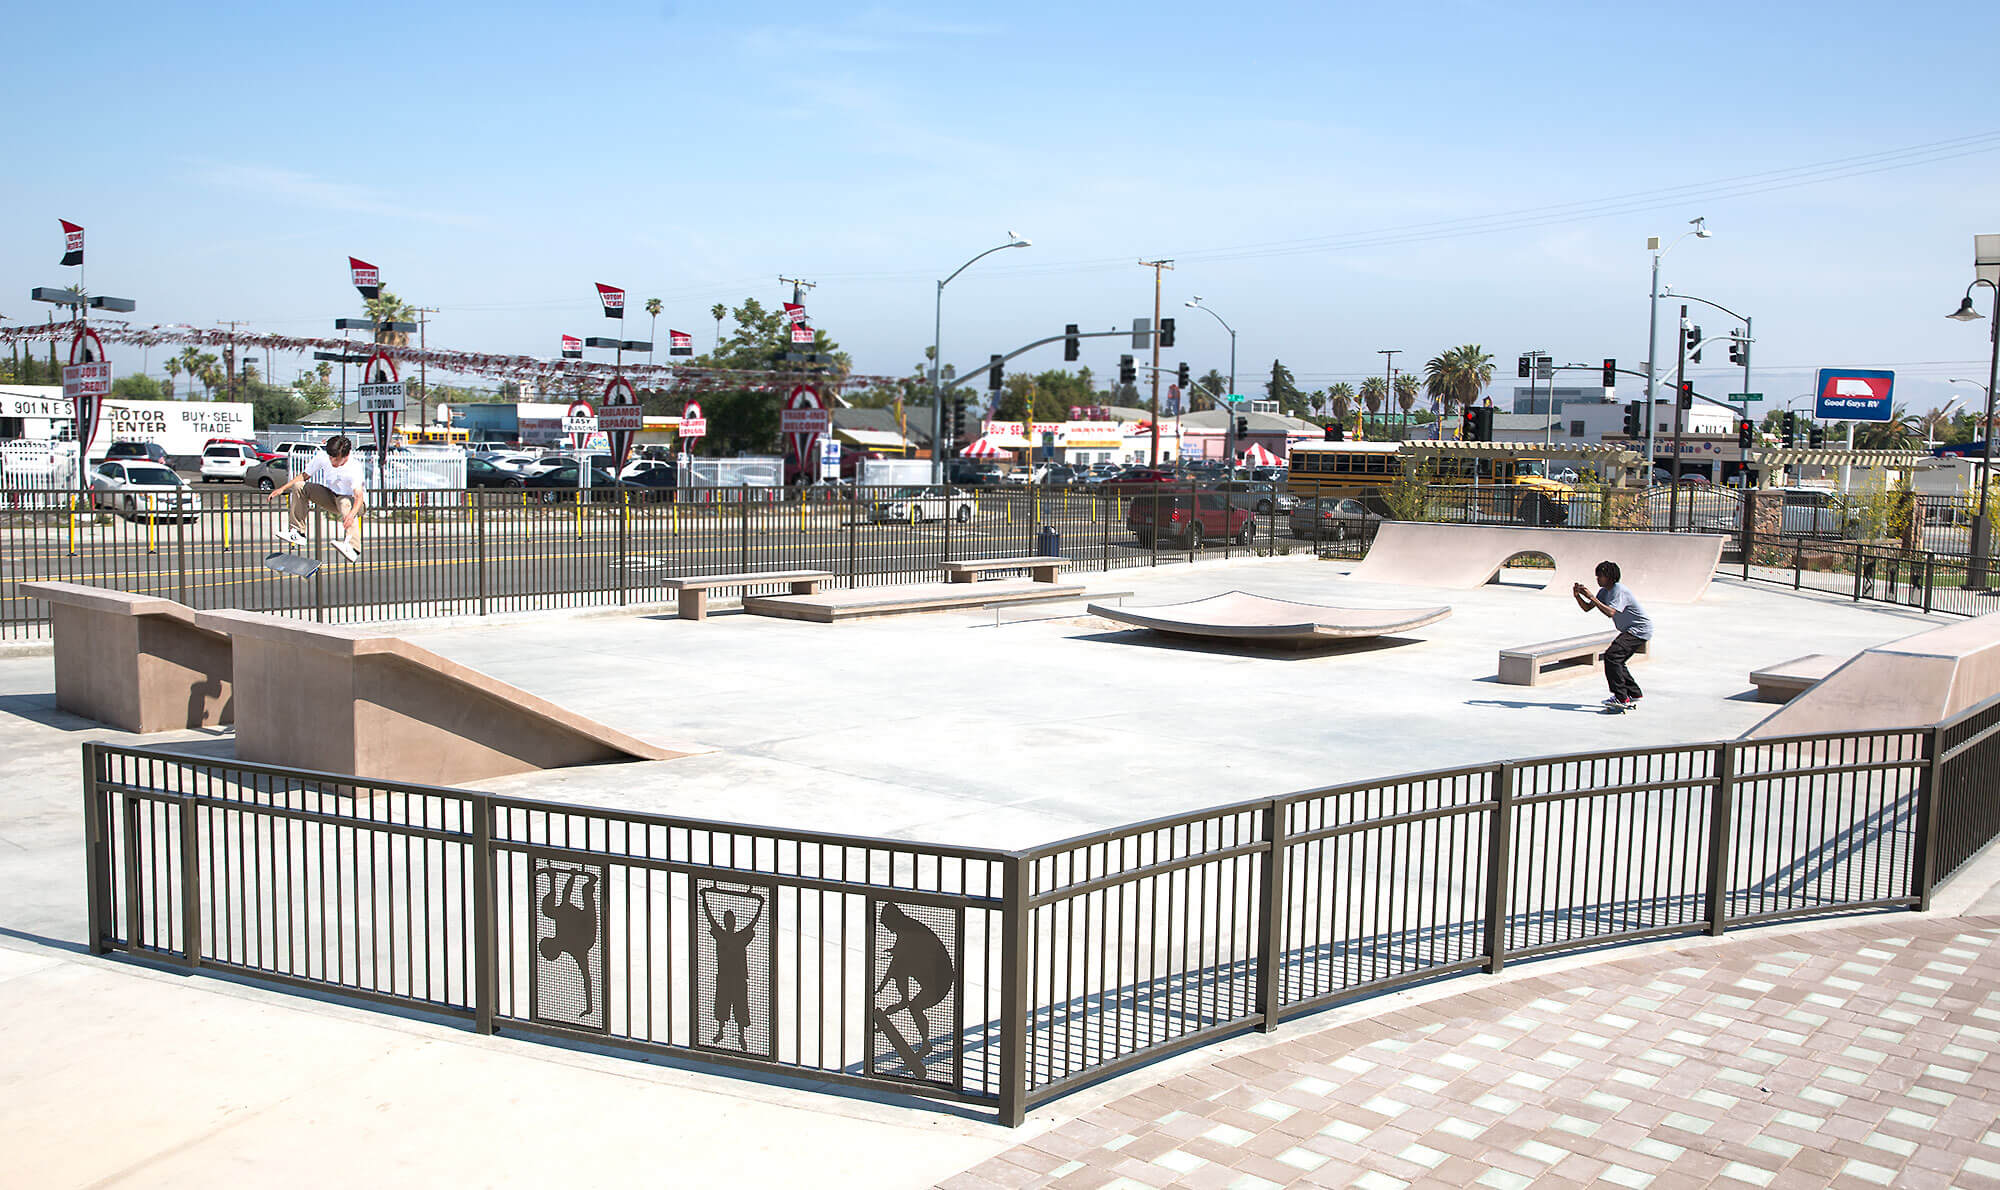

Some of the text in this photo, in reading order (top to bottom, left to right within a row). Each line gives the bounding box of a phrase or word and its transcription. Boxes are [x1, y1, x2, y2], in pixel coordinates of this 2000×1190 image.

[361, 385, 401, 396] BEST PRICES
[14, 401, 36, 414] 901
[374, 399, 395, 408] TOWN
[1846, 399, 1867, 408] Guys
[112, 421, 166, 433] ENTER
[193, 423, 231, 433] TRADE
[600, 417, 640, 428] ESPAÑOL
